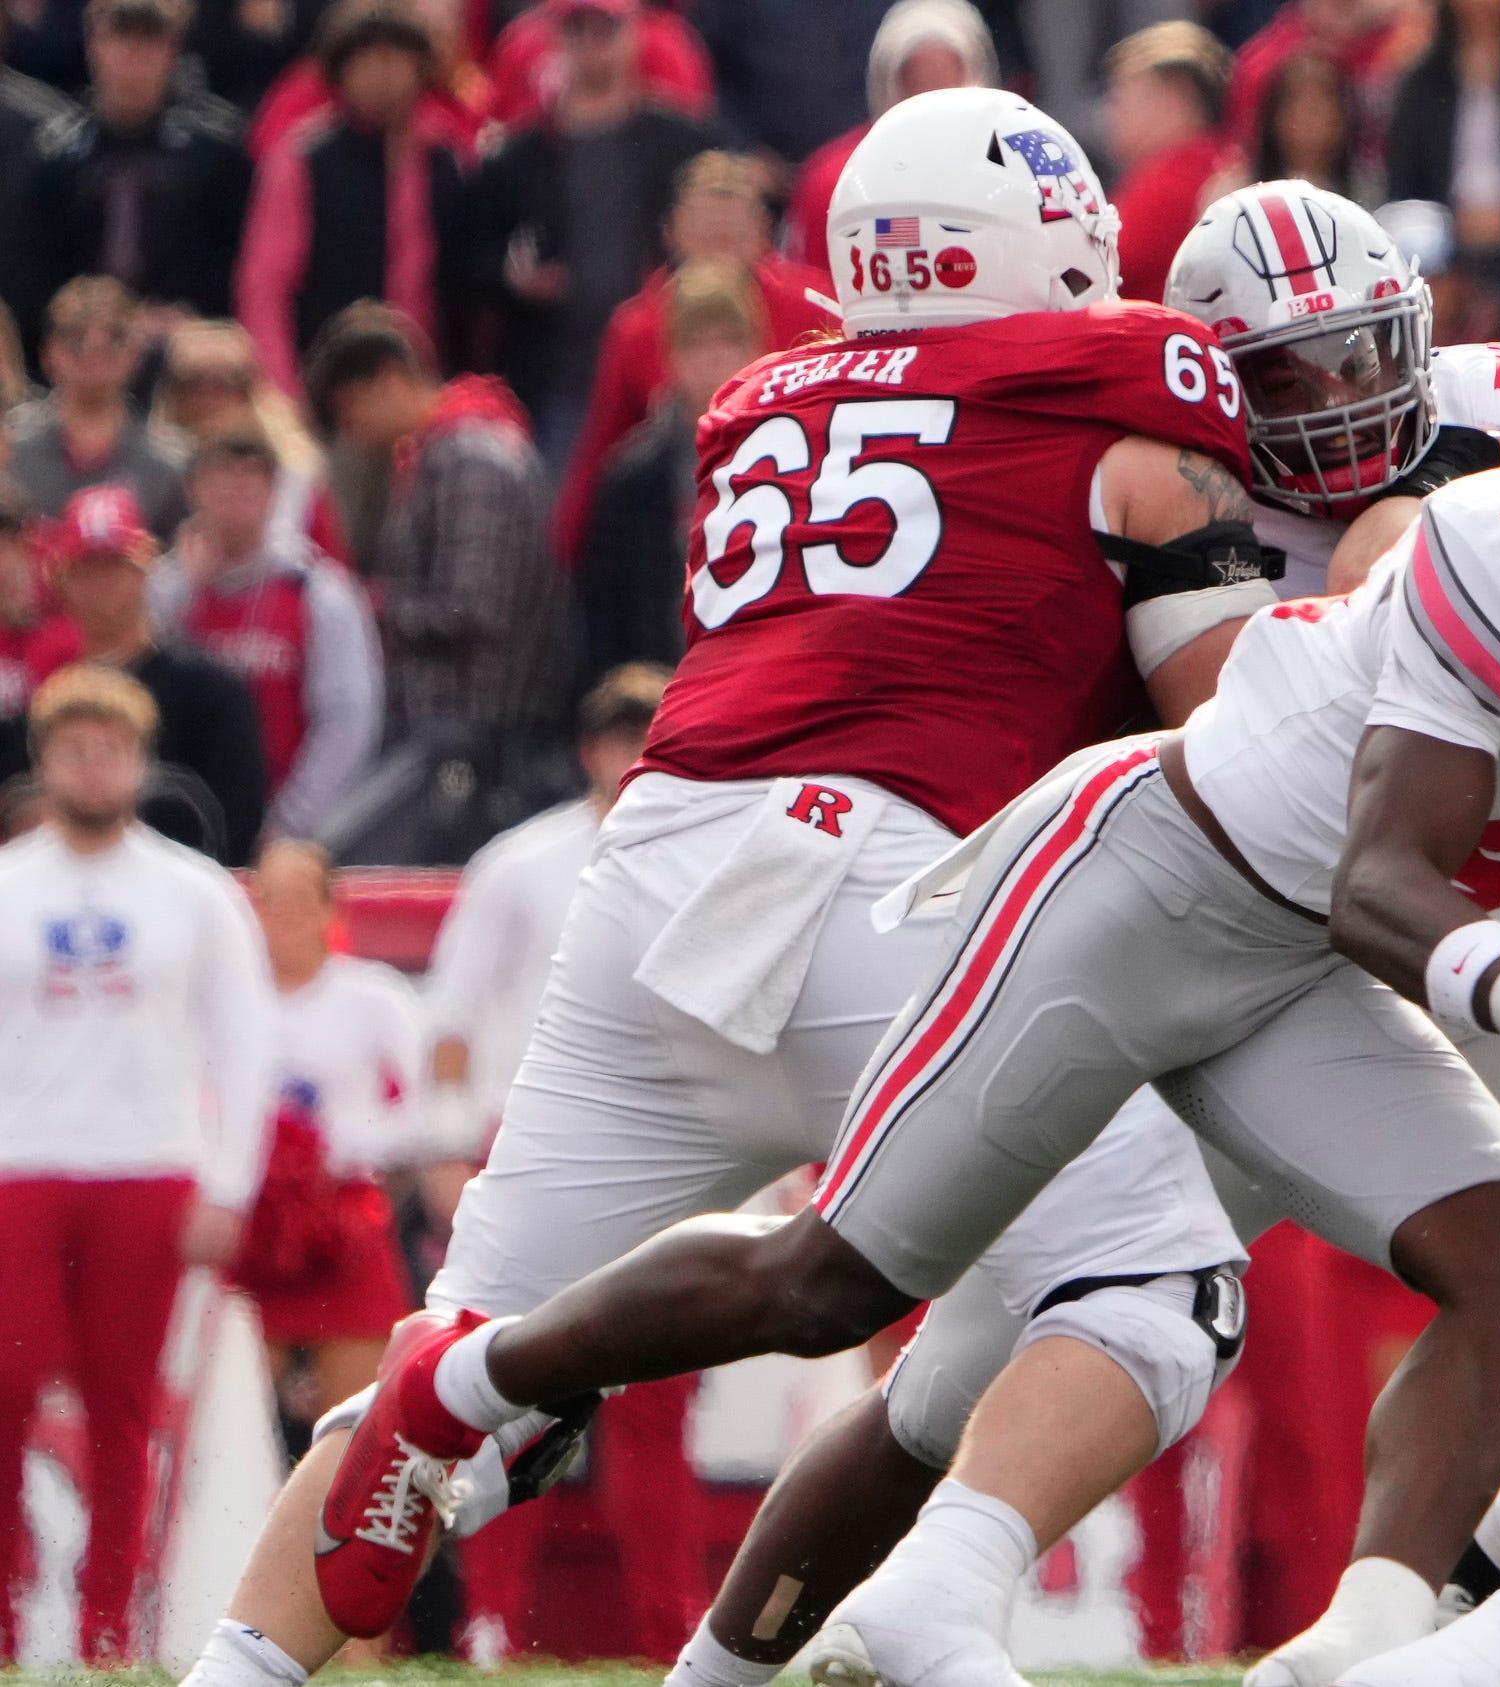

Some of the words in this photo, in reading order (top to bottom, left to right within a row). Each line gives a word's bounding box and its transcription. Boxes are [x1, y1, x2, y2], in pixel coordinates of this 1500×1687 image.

[870, 250, 931, 292] 65
[1163, 333, 1240, 420] 65
[690, 395, 958, 632] 65
[786, 783, 853, 838] R
